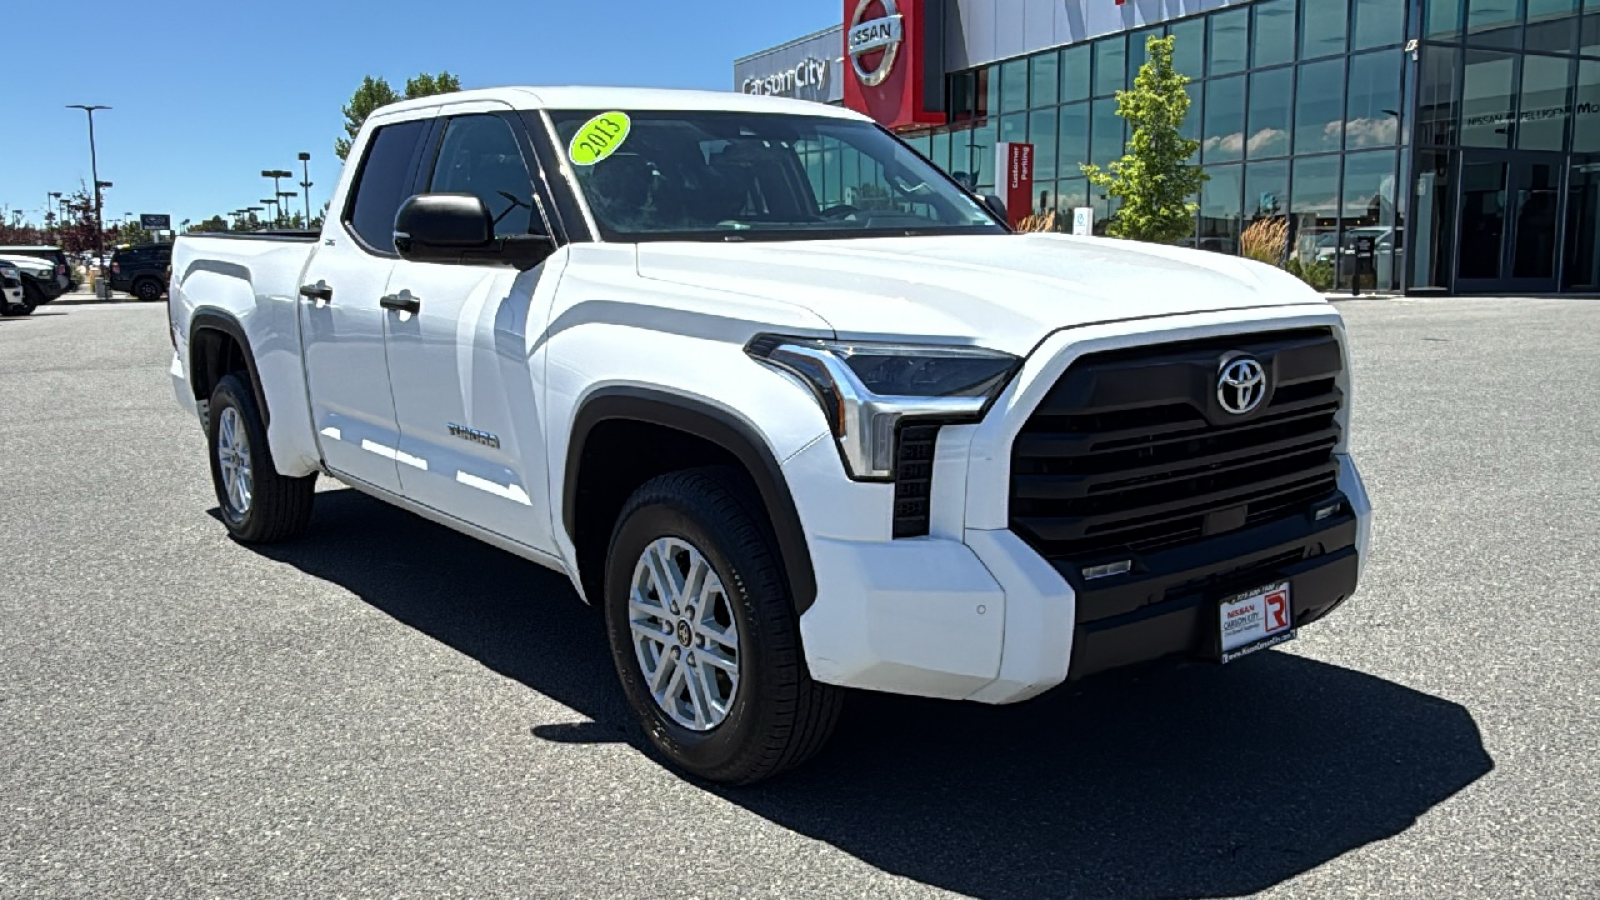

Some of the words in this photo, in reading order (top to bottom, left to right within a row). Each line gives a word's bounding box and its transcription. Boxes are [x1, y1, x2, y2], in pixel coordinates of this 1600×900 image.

[742, 70, 795, 96] Carson
[795, 58, 826, 91] City
[1468, 114, 1503, 126] NISSAN
[580, 118, 621, 157] 2013
[1021, 146, 1030, 180] Parking
[1224, 616, 1247, 631] CARSON
[1247, 612, 1260, 622] CITY
[1227, 604, 1255, 619] NISSAN
